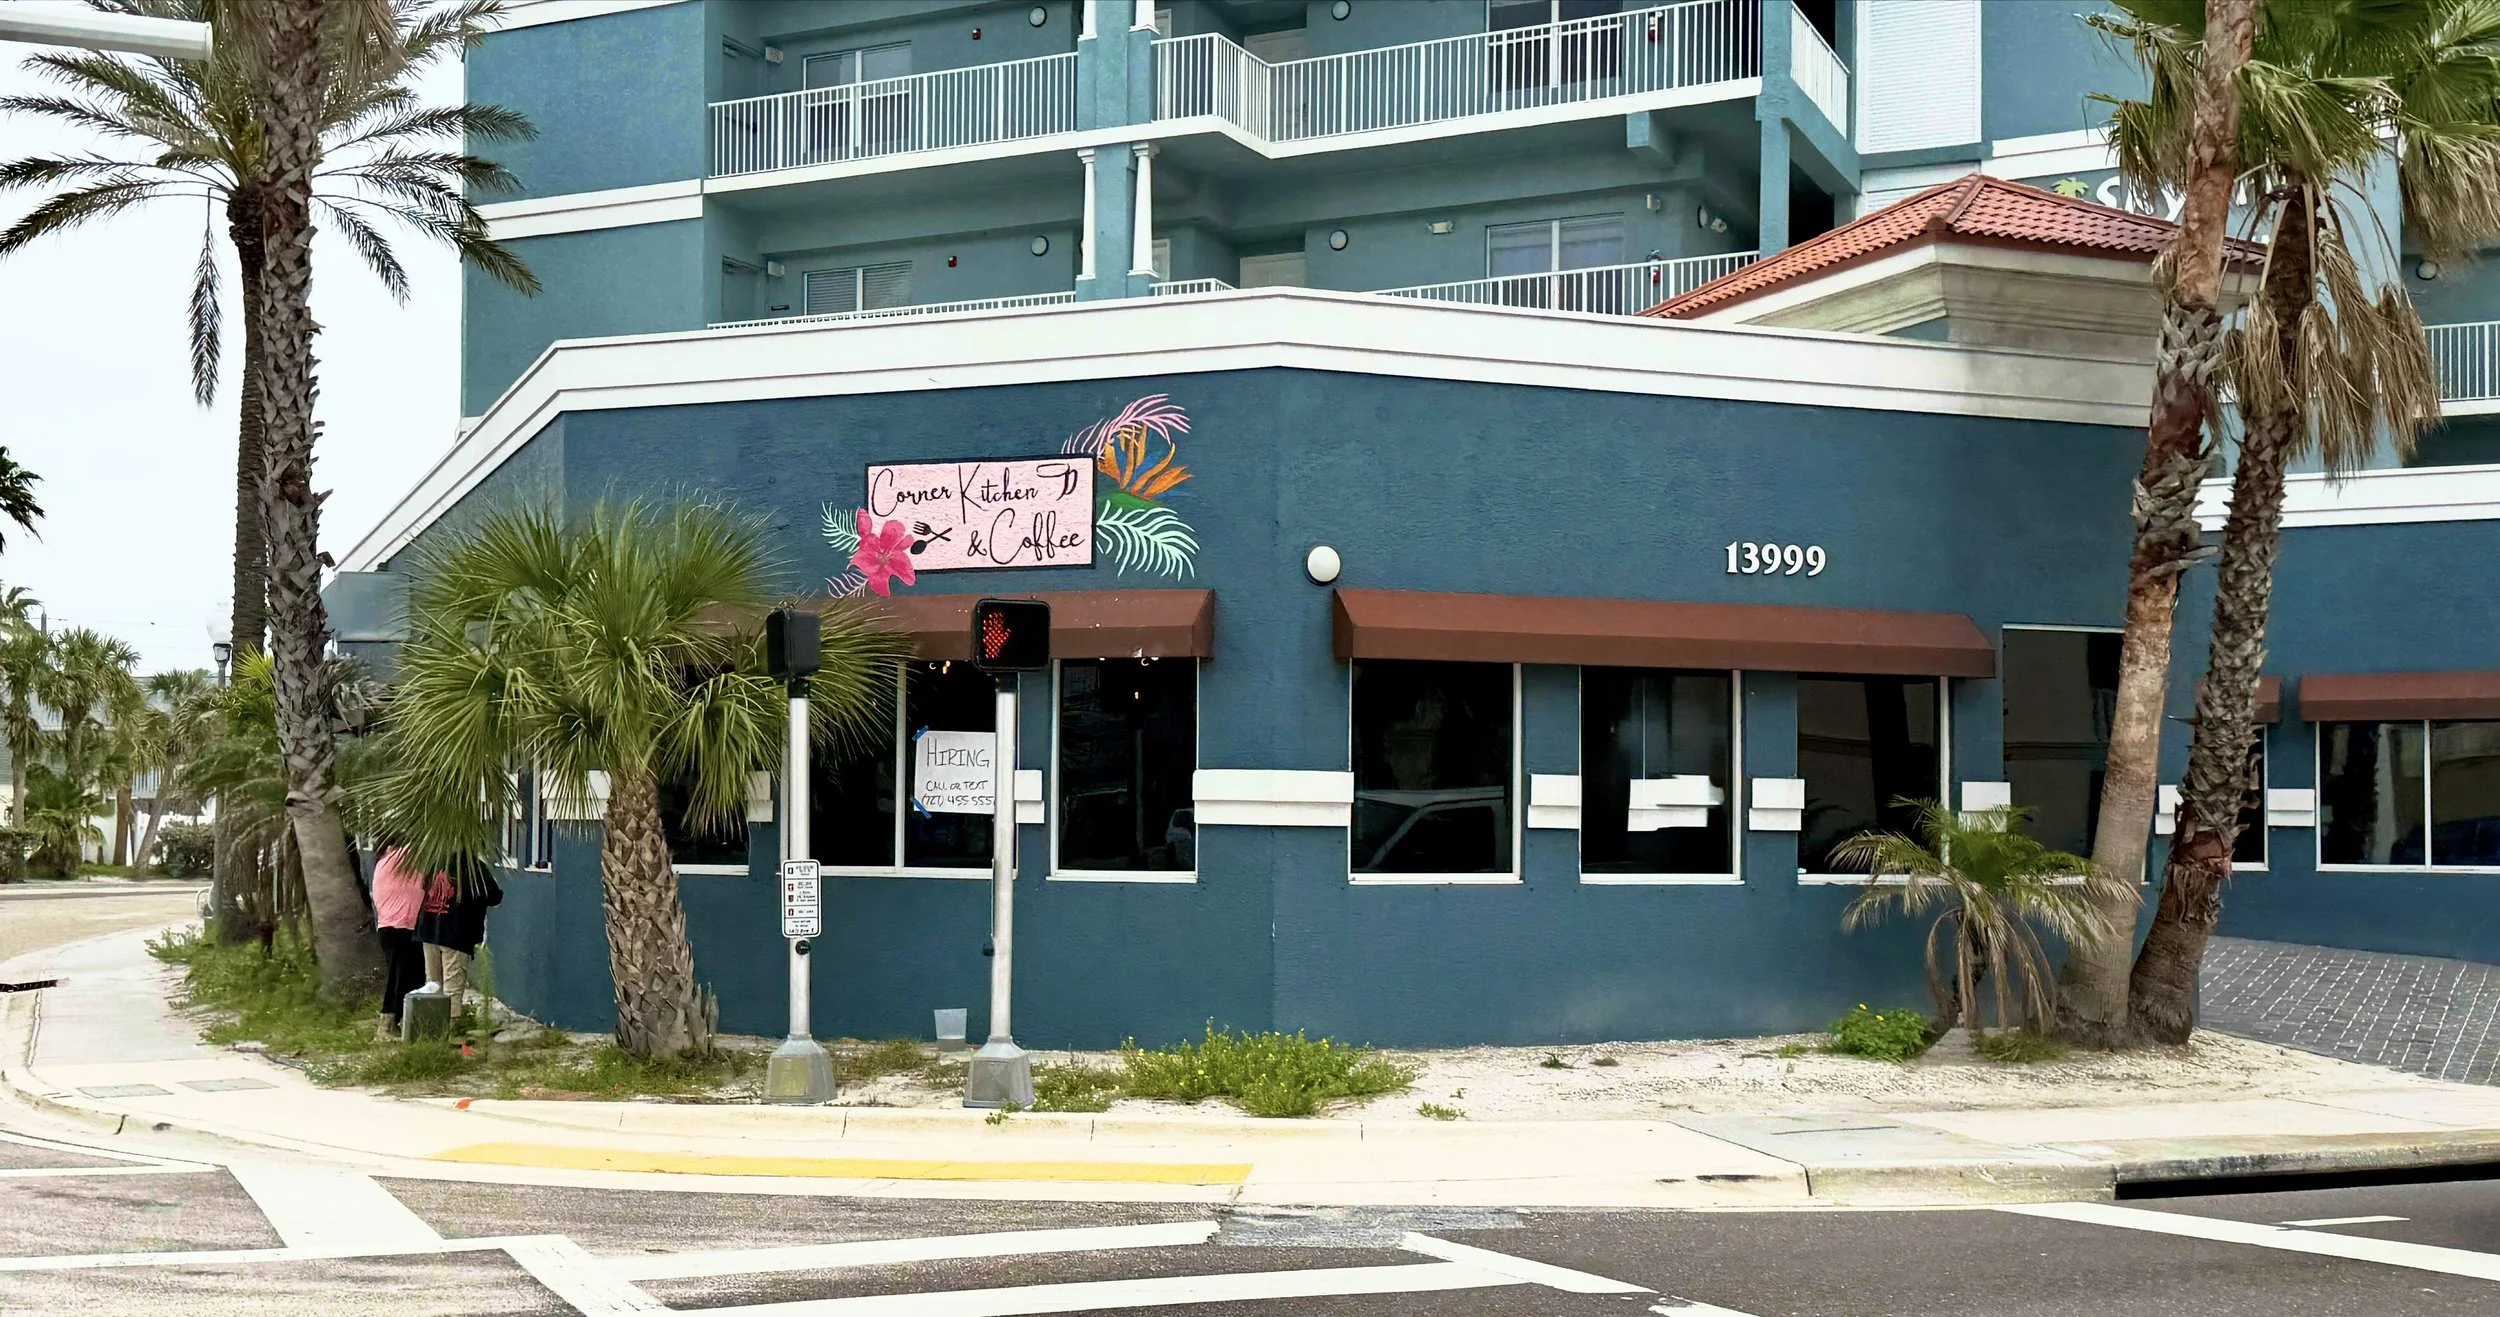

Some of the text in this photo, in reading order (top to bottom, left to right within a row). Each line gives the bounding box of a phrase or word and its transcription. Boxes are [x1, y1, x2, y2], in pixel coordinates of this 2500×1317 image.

[871, 463, 1039, 524] Corner Kitchen
[967, 508, 1085, 565] & Coffee
[1724, 541, 1826, 577] 13999
[926, 737, 990, 768] HIRING
